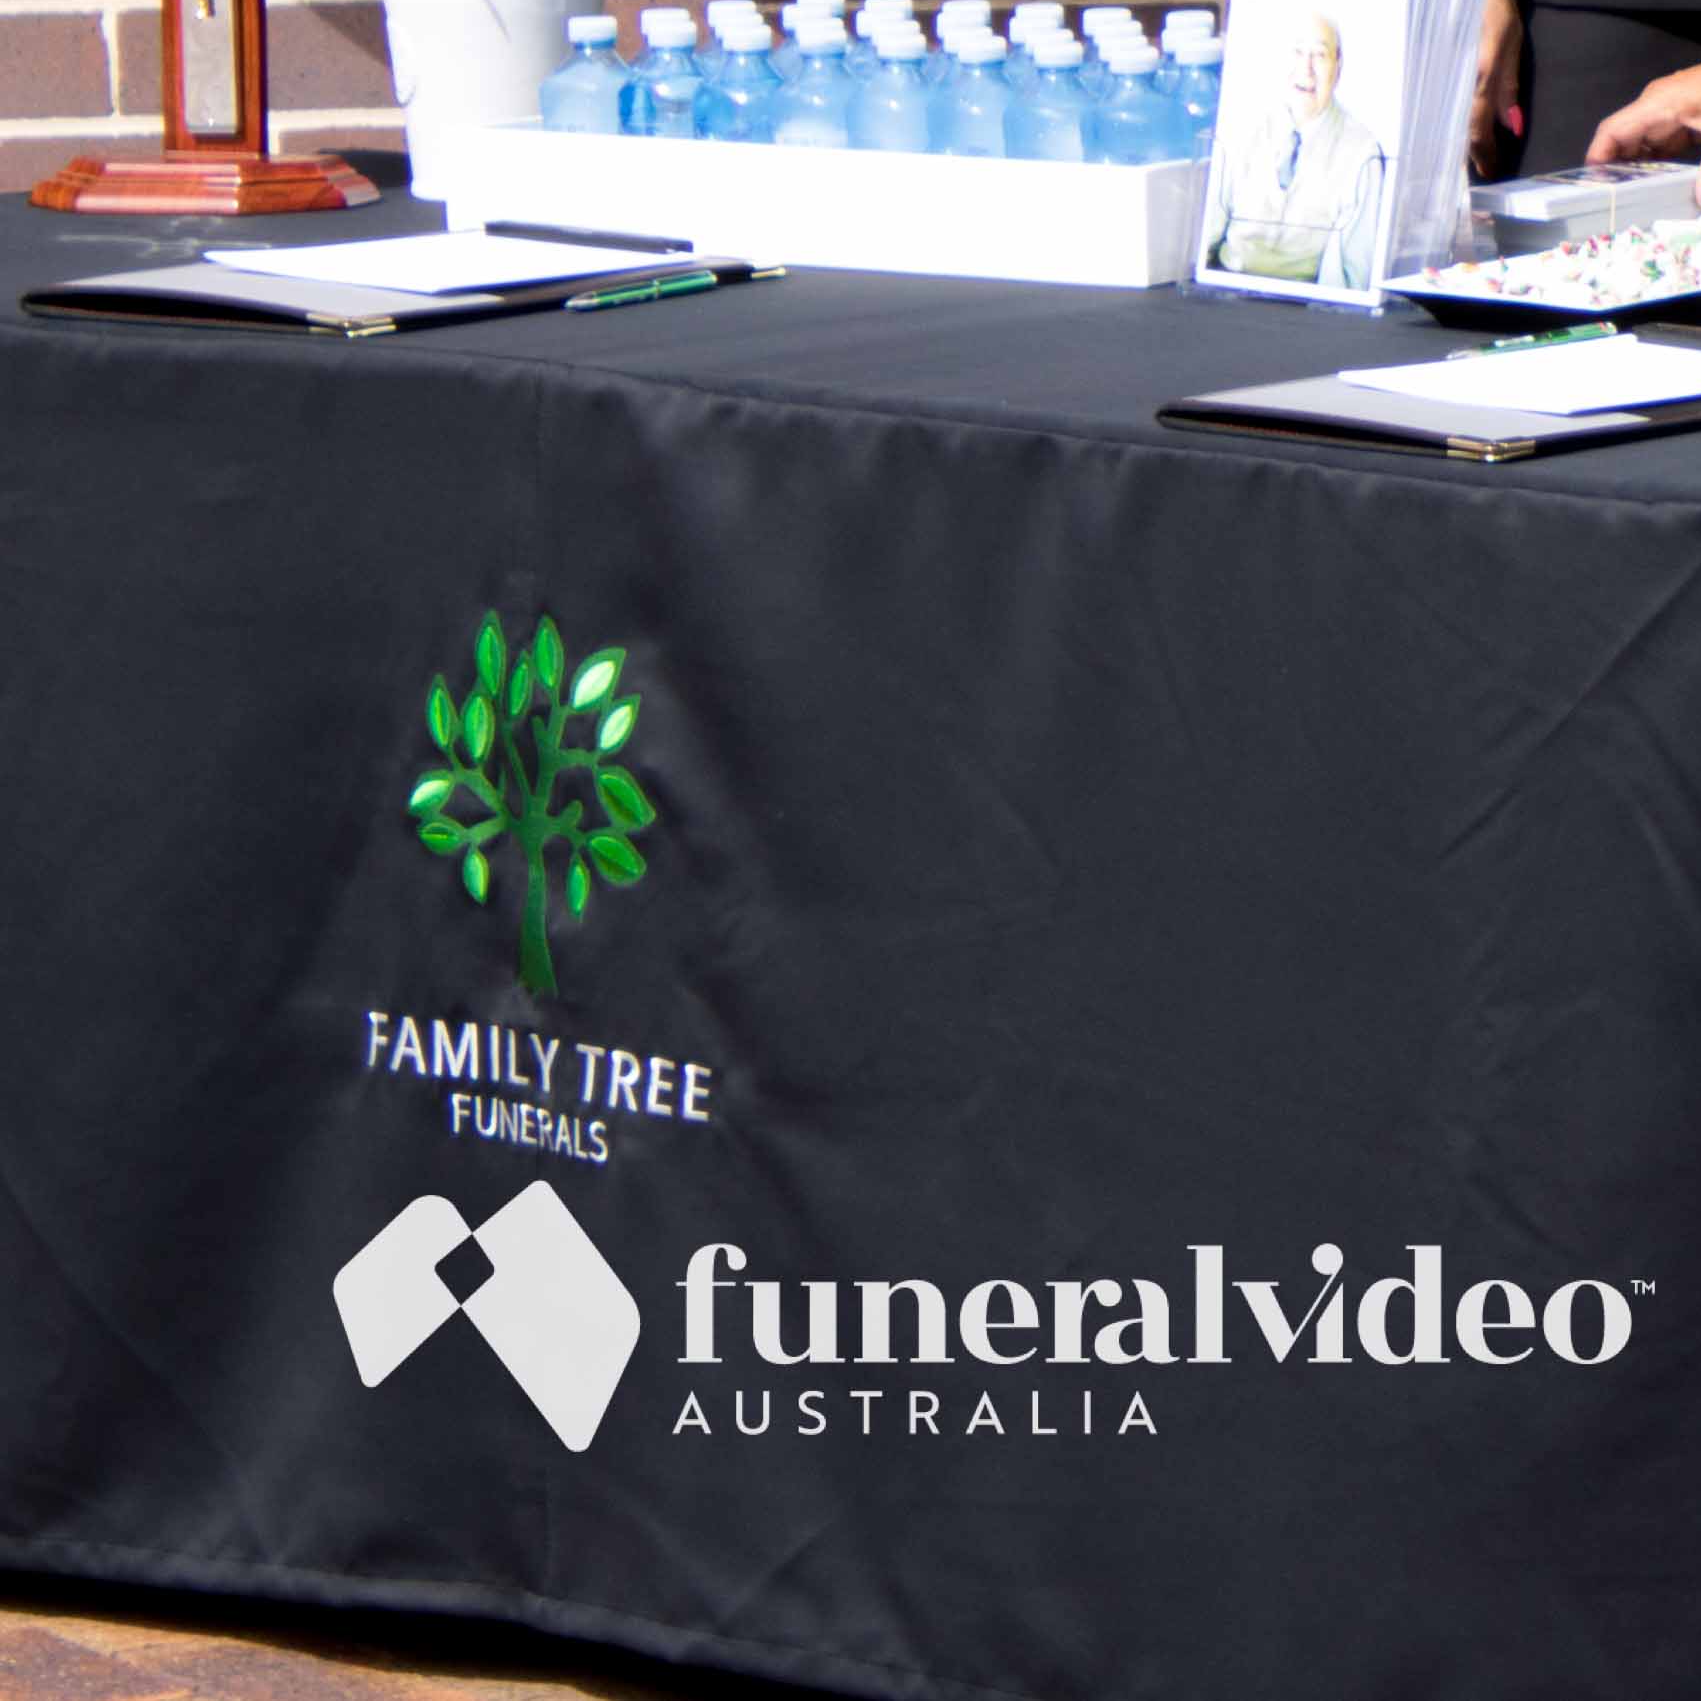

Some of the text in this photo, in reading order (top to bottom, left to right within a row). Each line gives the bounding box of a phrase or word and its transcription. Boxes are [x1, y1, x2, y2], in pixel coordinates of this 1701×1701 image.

[366, 1011, 714, 1123] FAMILY TREE
[451, 1094, 610, 1163] FUNERALS
